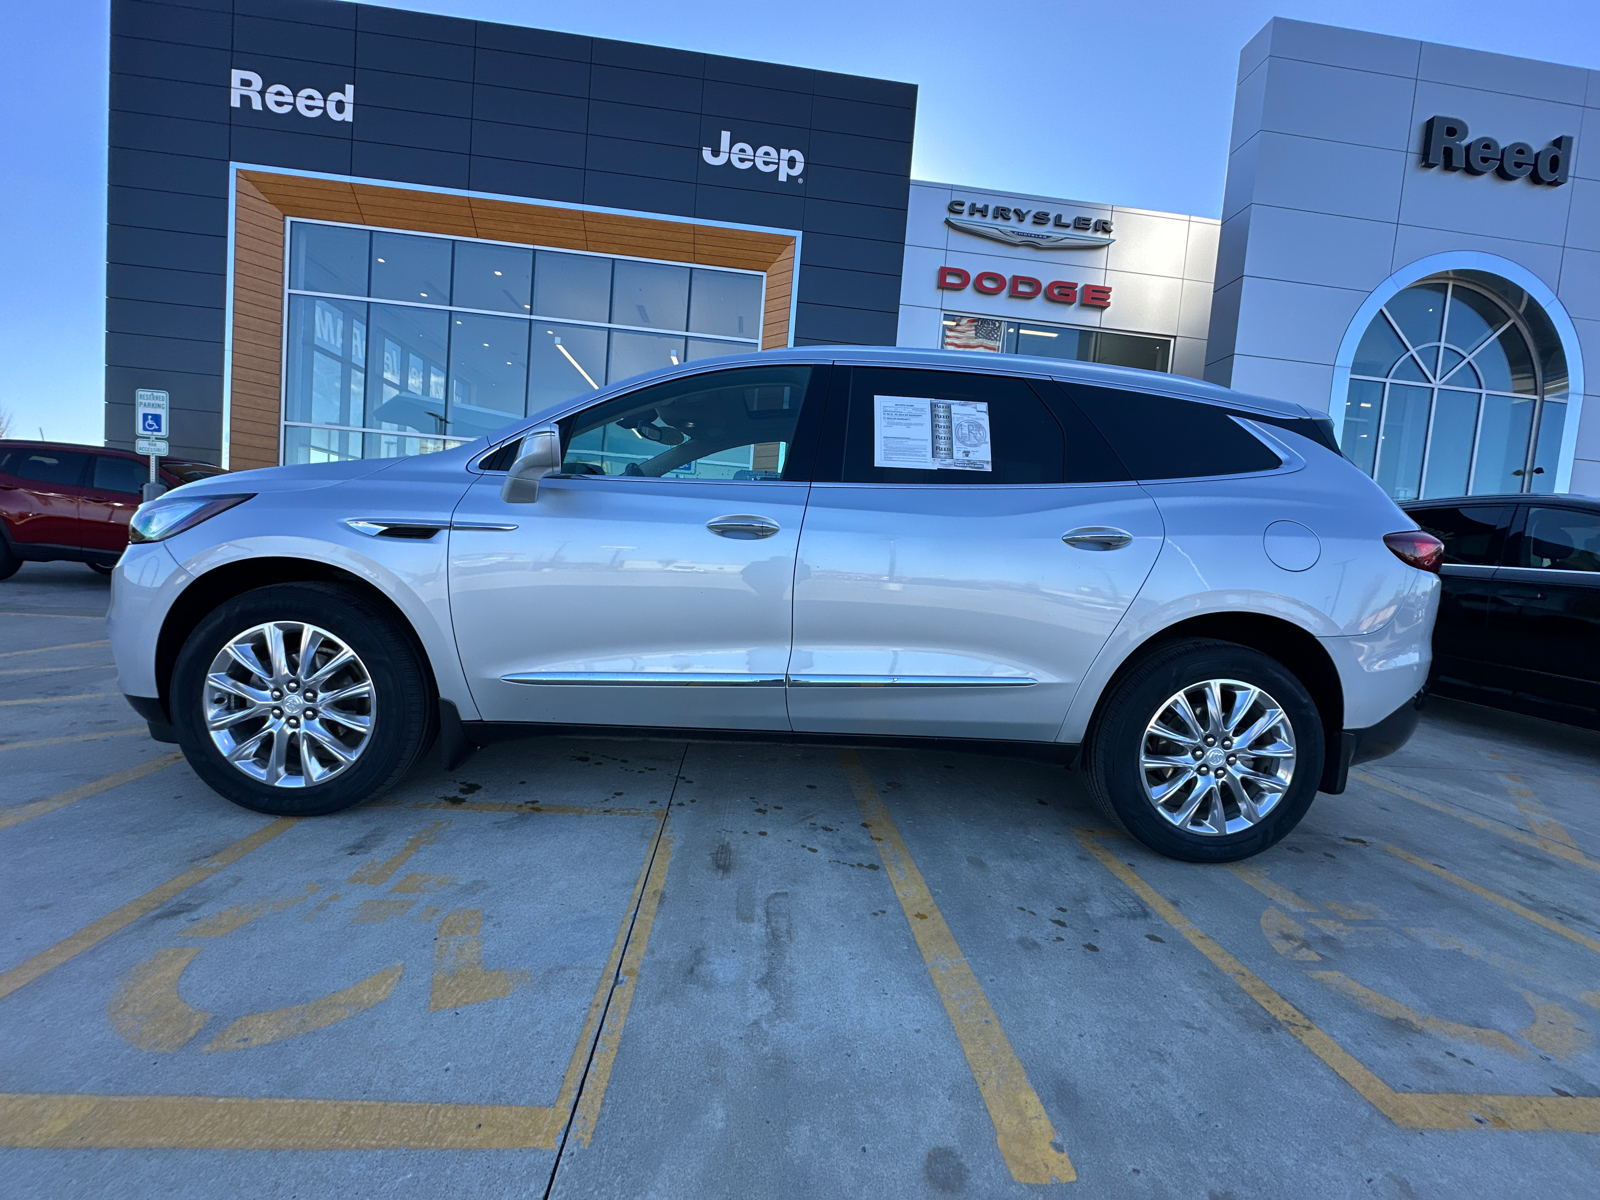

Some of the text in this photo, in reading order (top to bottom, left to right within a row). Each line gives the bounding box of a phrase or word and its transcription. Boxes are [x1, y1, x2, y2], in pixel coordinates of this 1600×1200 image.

[230, 68, 355, 122] Reed
[702, 130, 805, 182] Jeep
[1421, 115, 1574, 187] Reed
[948, 200, 1113, 233] CHRYSLER
[937, 266, 1113, 309] DODGE
[139, 401, 165, 410] PARKING
